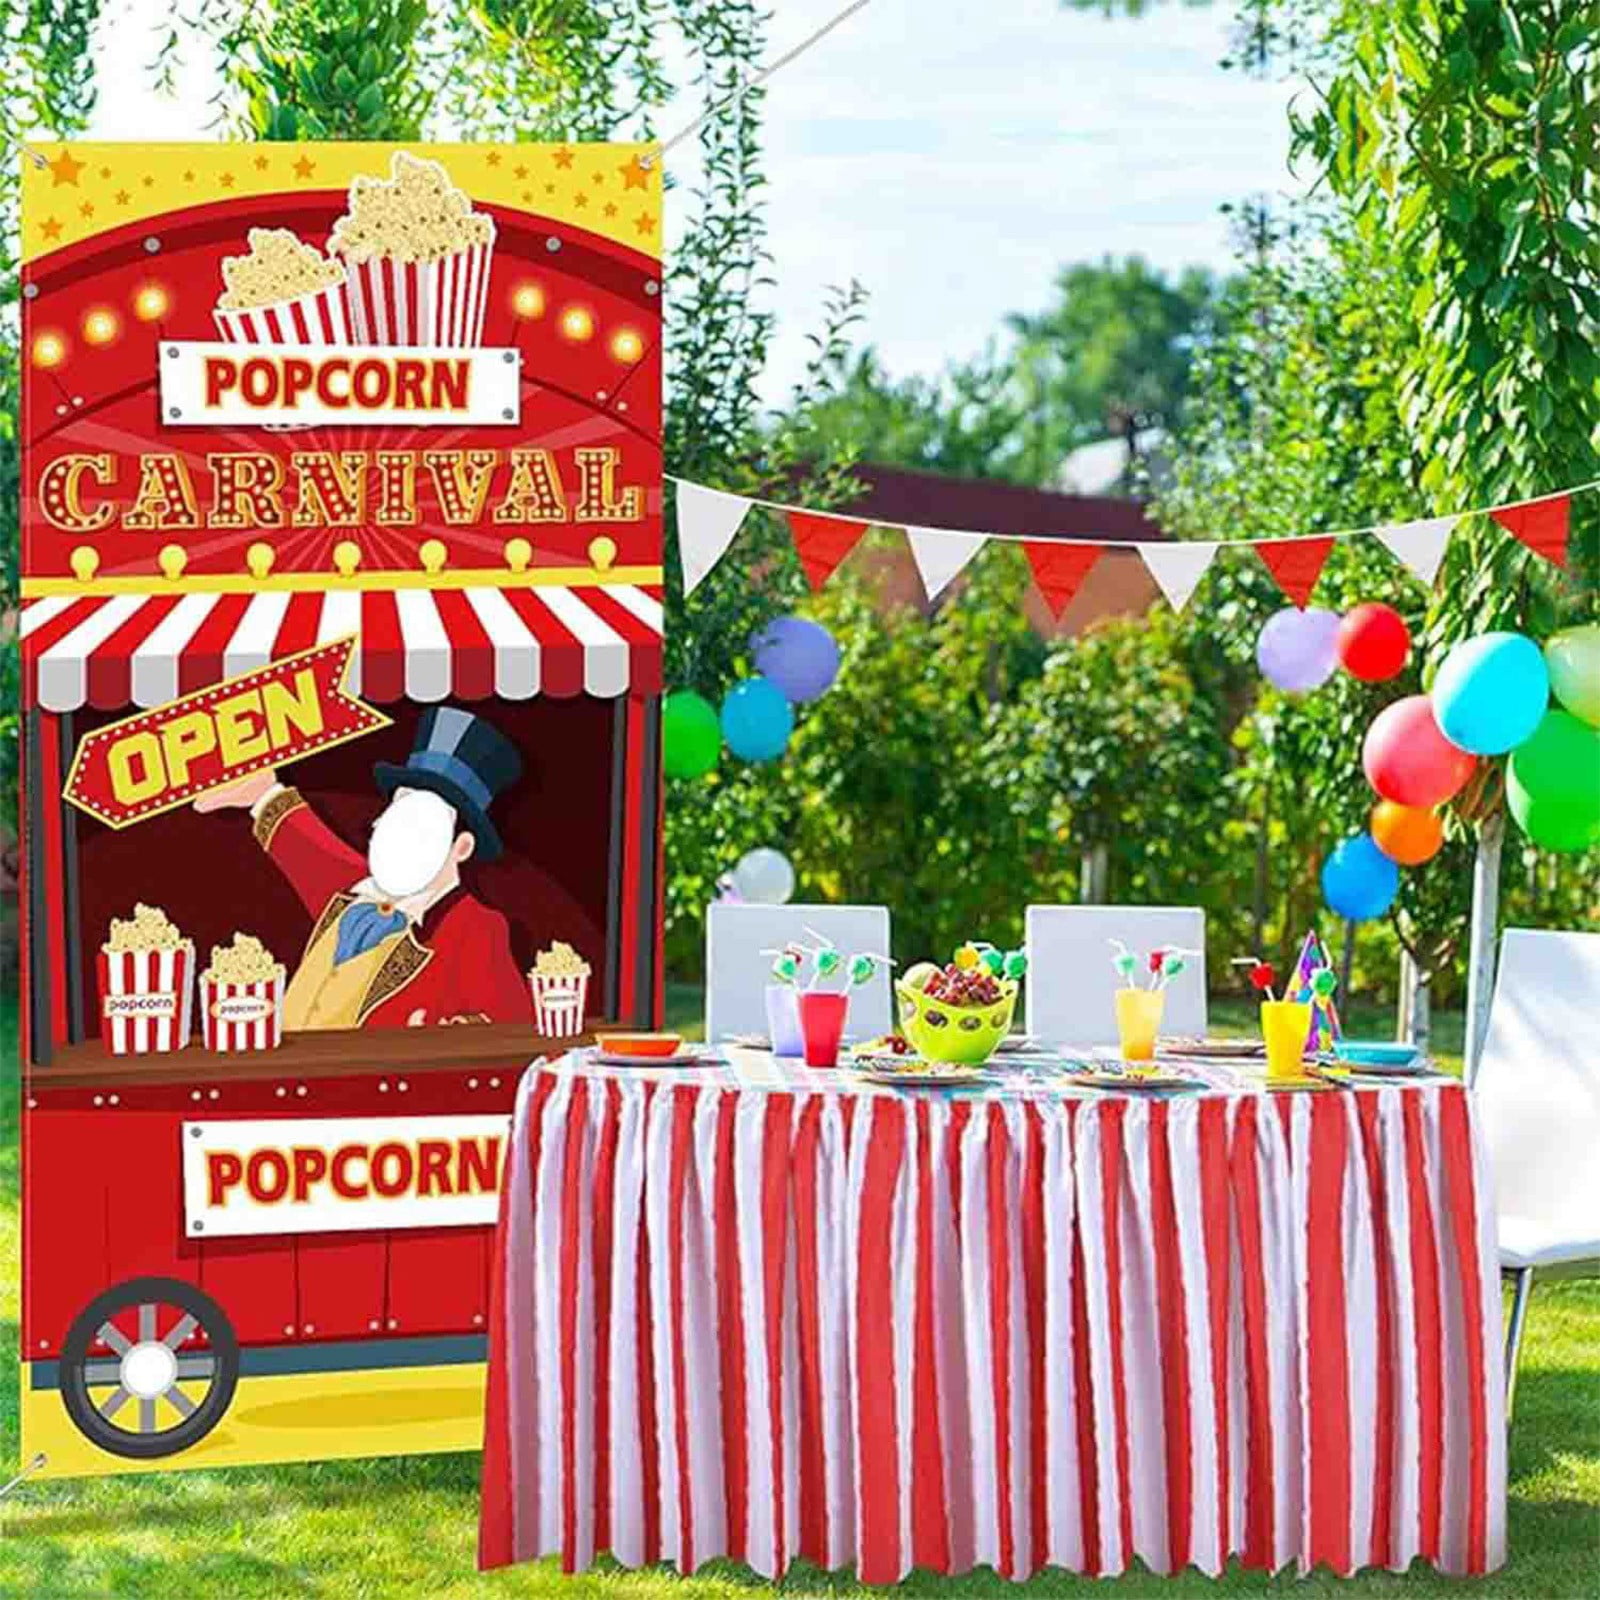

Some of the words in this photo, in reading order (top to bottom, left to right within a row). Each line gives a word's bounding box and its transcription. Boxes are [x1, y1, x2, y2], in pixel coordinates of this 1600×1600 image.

[206, 357, 470, 409] POPCORN
[40, 447, 640, 531] CARNIVAL
[106, 671, 324, 806] OPEN
[108, 999, 173, 1011] popcorn
[220, 1004, 265, 1014] popc
[206, 1135, 501, 1207] POPCORN
